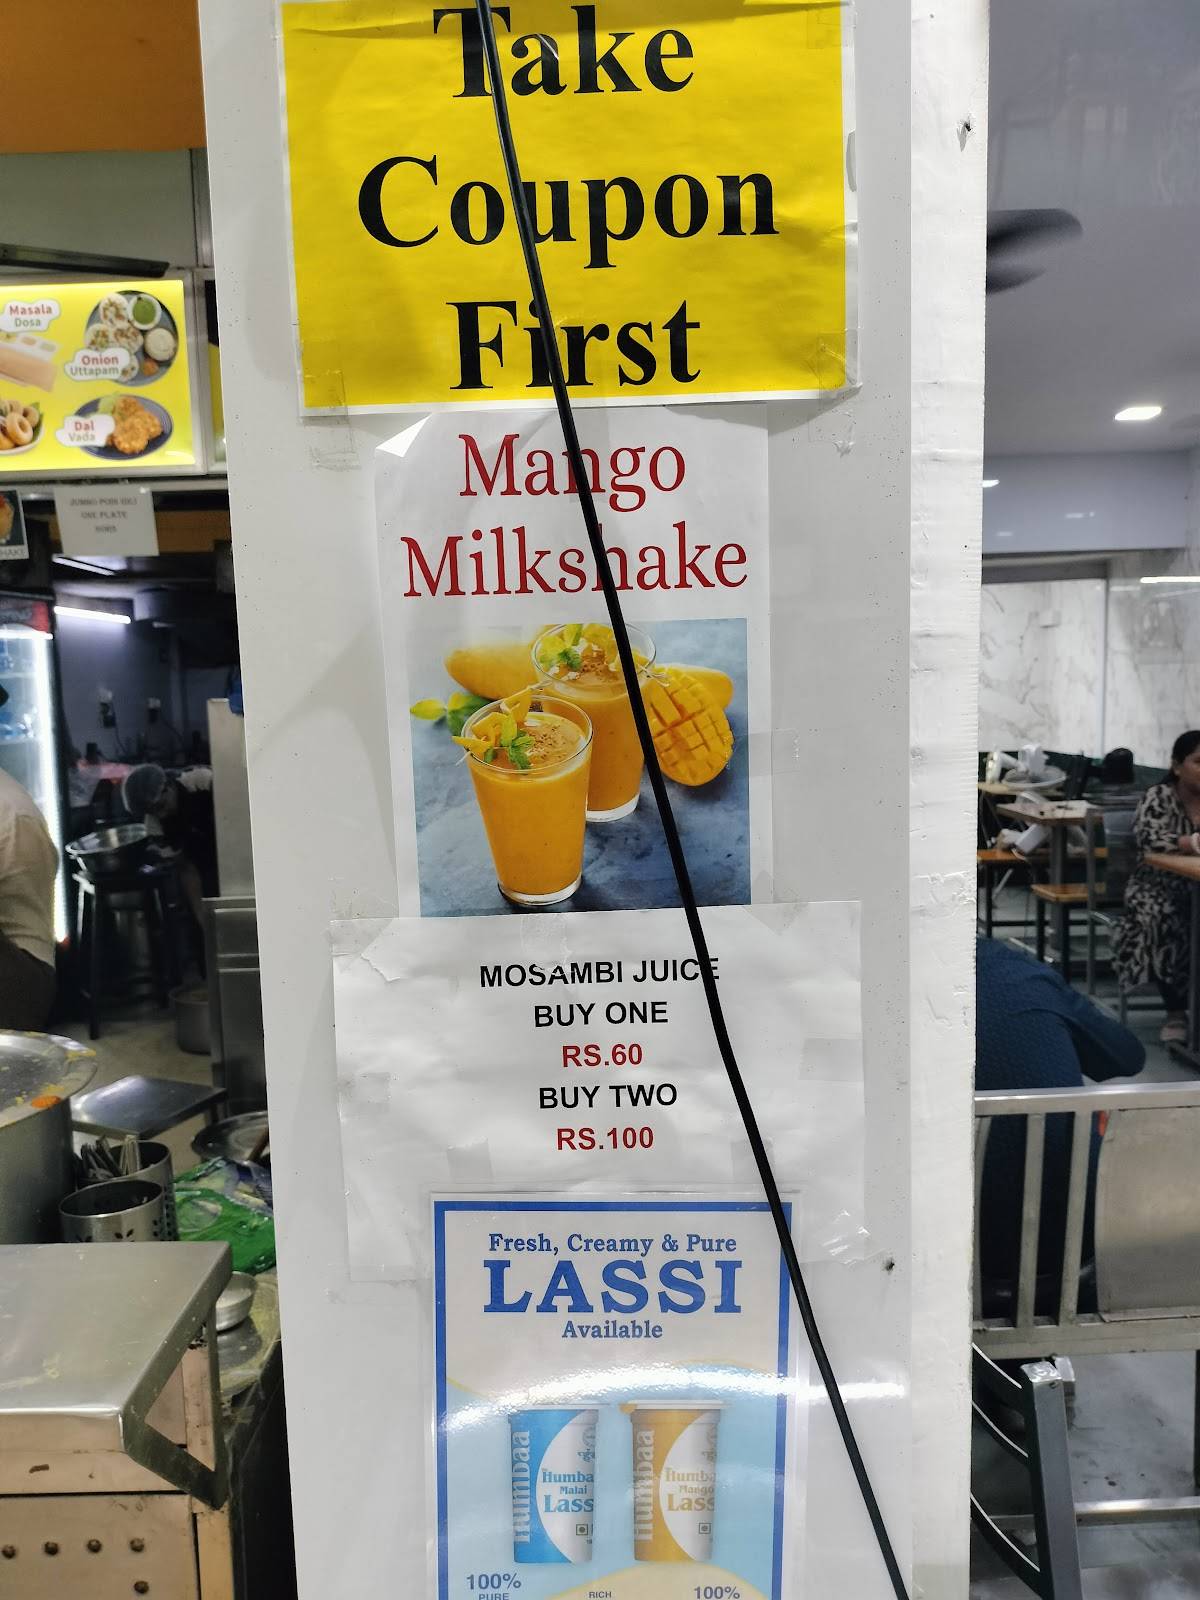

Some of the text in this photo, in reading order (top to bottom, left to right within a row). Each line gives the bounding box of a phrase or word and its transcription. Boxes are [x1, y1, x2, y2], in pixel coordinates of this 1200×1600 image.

[433, 5, 694, 98] Take
[358, 155, 779, 269] Coupon
[9, 304, 52, 316] Masala
[15, 318, 41, 327] Dosa
[446, 300, 701, 390] First
[70, 366, 119, 376] Uttapam
[81, 355, 119, 365] Onion
[68, 432, 95, 442] Vada
[74, 420, 94, 431] Dal
[458, 433, 685, 512] Mango
[400, 521, 748, 597] Milkshake
[480, 958, 719, 988] MOSAMBI JUICE
[534, 1001, 668, 1028] BUY ONE
[562, 1043, 643, 1068] RS.60
[539, 1083, 677, 1109] BUY TWO
[557, 1127, 654, 1150] RS.100
[489, 1233, 737, 1257] Fresh, Creamy & Pure
[483, 1259, 743, 1314] LASSI
[561, 1320, 663, 1339] Available
[560, 1485, 587, 1494] Malai
[466, 1573, 521, 1590] 100%
[694, 1586, 740, 1600] 100%
[588, 1591, 612, 1599] RICH
